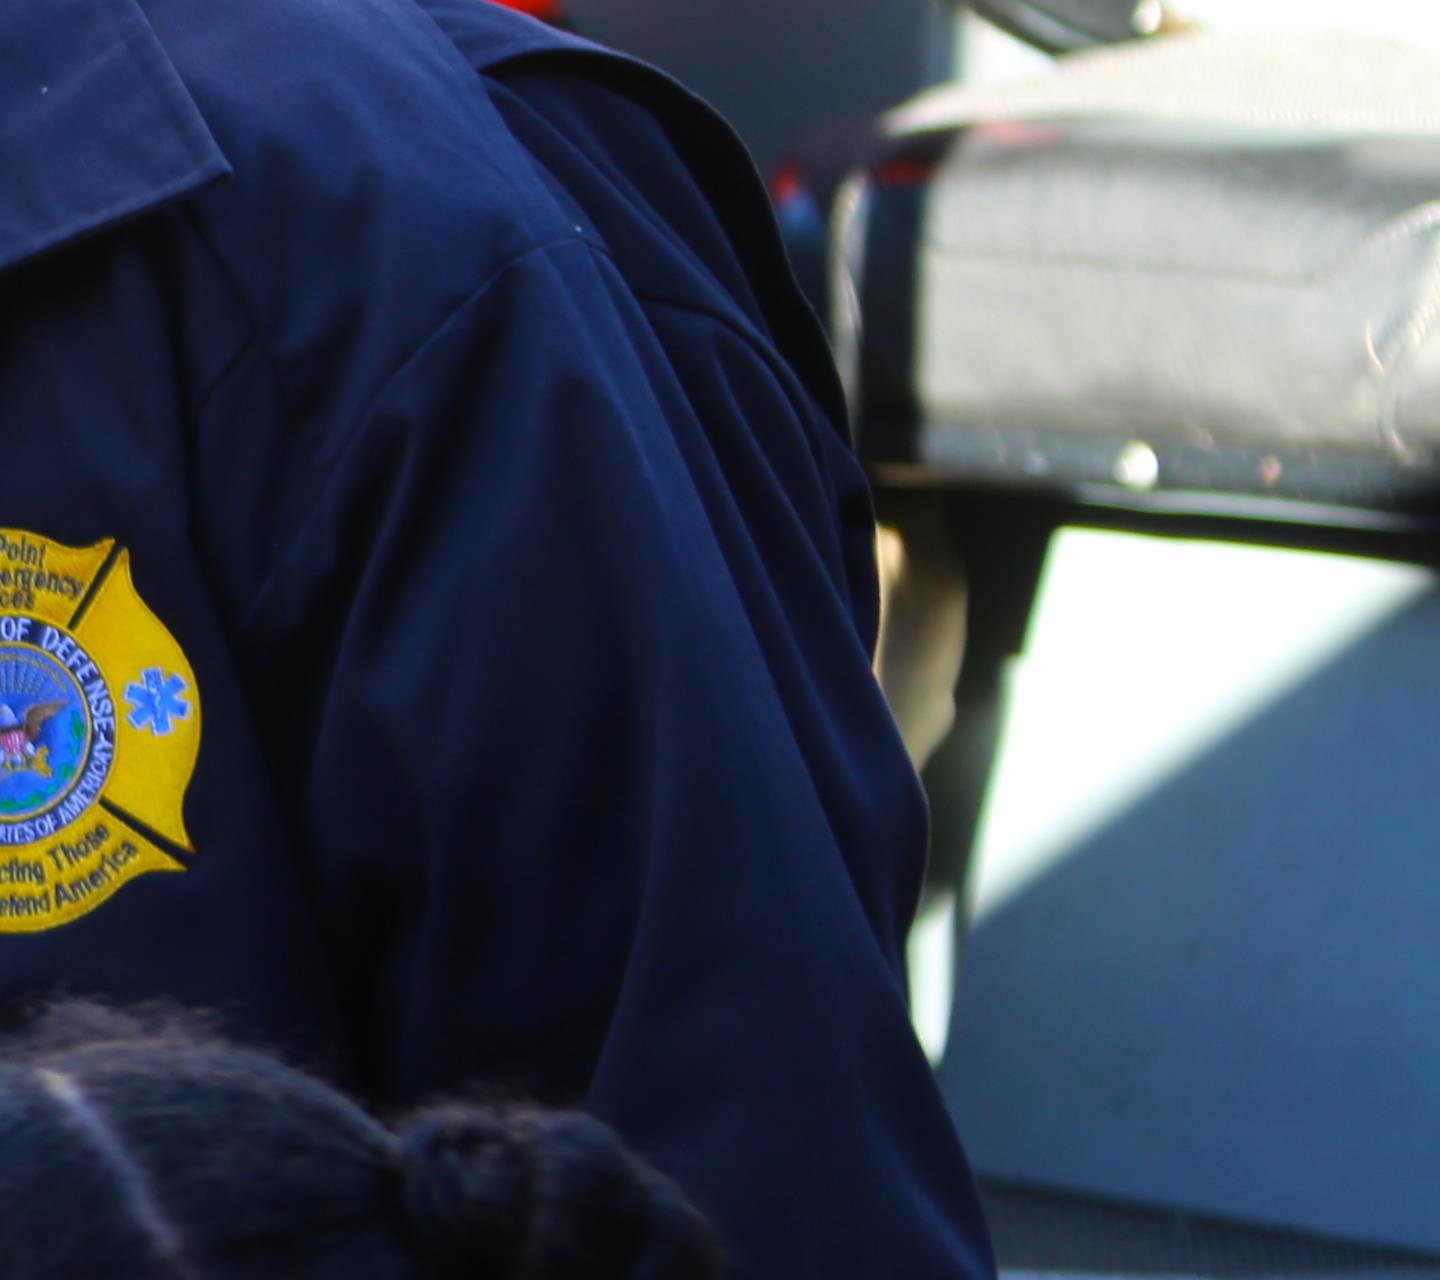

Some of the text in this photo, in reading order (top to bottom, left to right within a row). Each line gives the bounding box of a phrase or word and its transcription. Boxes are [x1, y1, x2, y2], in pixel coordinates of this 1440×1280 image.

[0, 616, 32, 642] OF
[41, 626, 115, 732] DEFENSE
[35, 815, 58, 838] OF
[57, 749, 113, 825] AMERICA
[47, 823, 111, 871] Those
[53, 840, 140, 908] America
